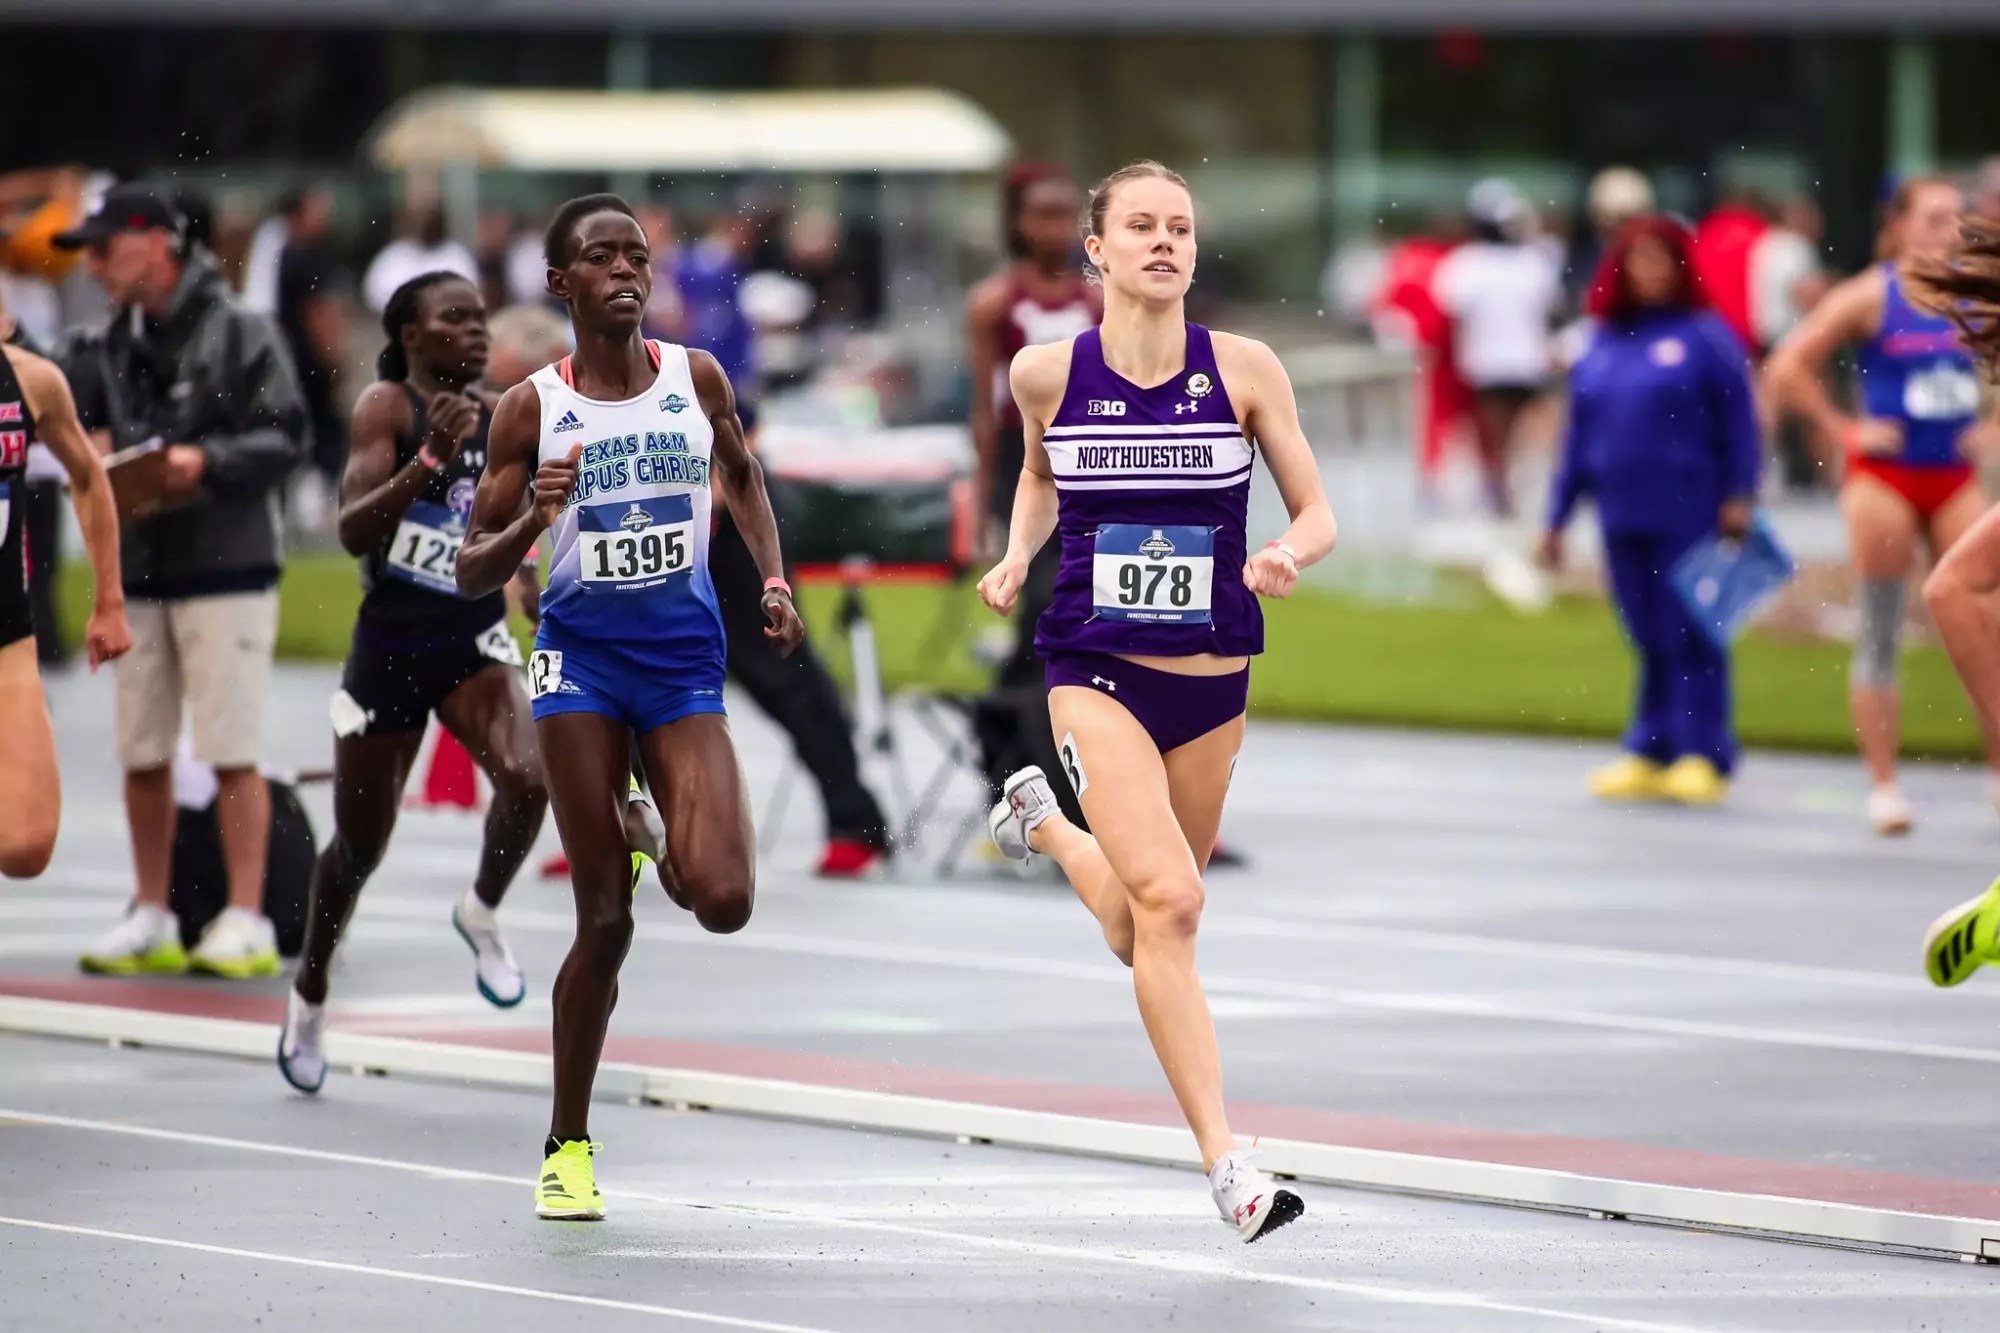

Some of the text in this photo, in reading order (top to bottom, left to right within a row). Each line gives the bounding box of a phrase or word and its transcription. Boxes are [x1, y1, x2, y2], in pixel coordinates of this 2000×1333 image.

[553, 422, 584, 434] adidas
[1, 430, 26, 466] H
[578, 432, 690, 467] EXAS A&M
[1077, 445, 1213, 469] NORTHWESTERN
[594, 530, 684, 577] 1395
[1118, 563, 1191, 607] 978
